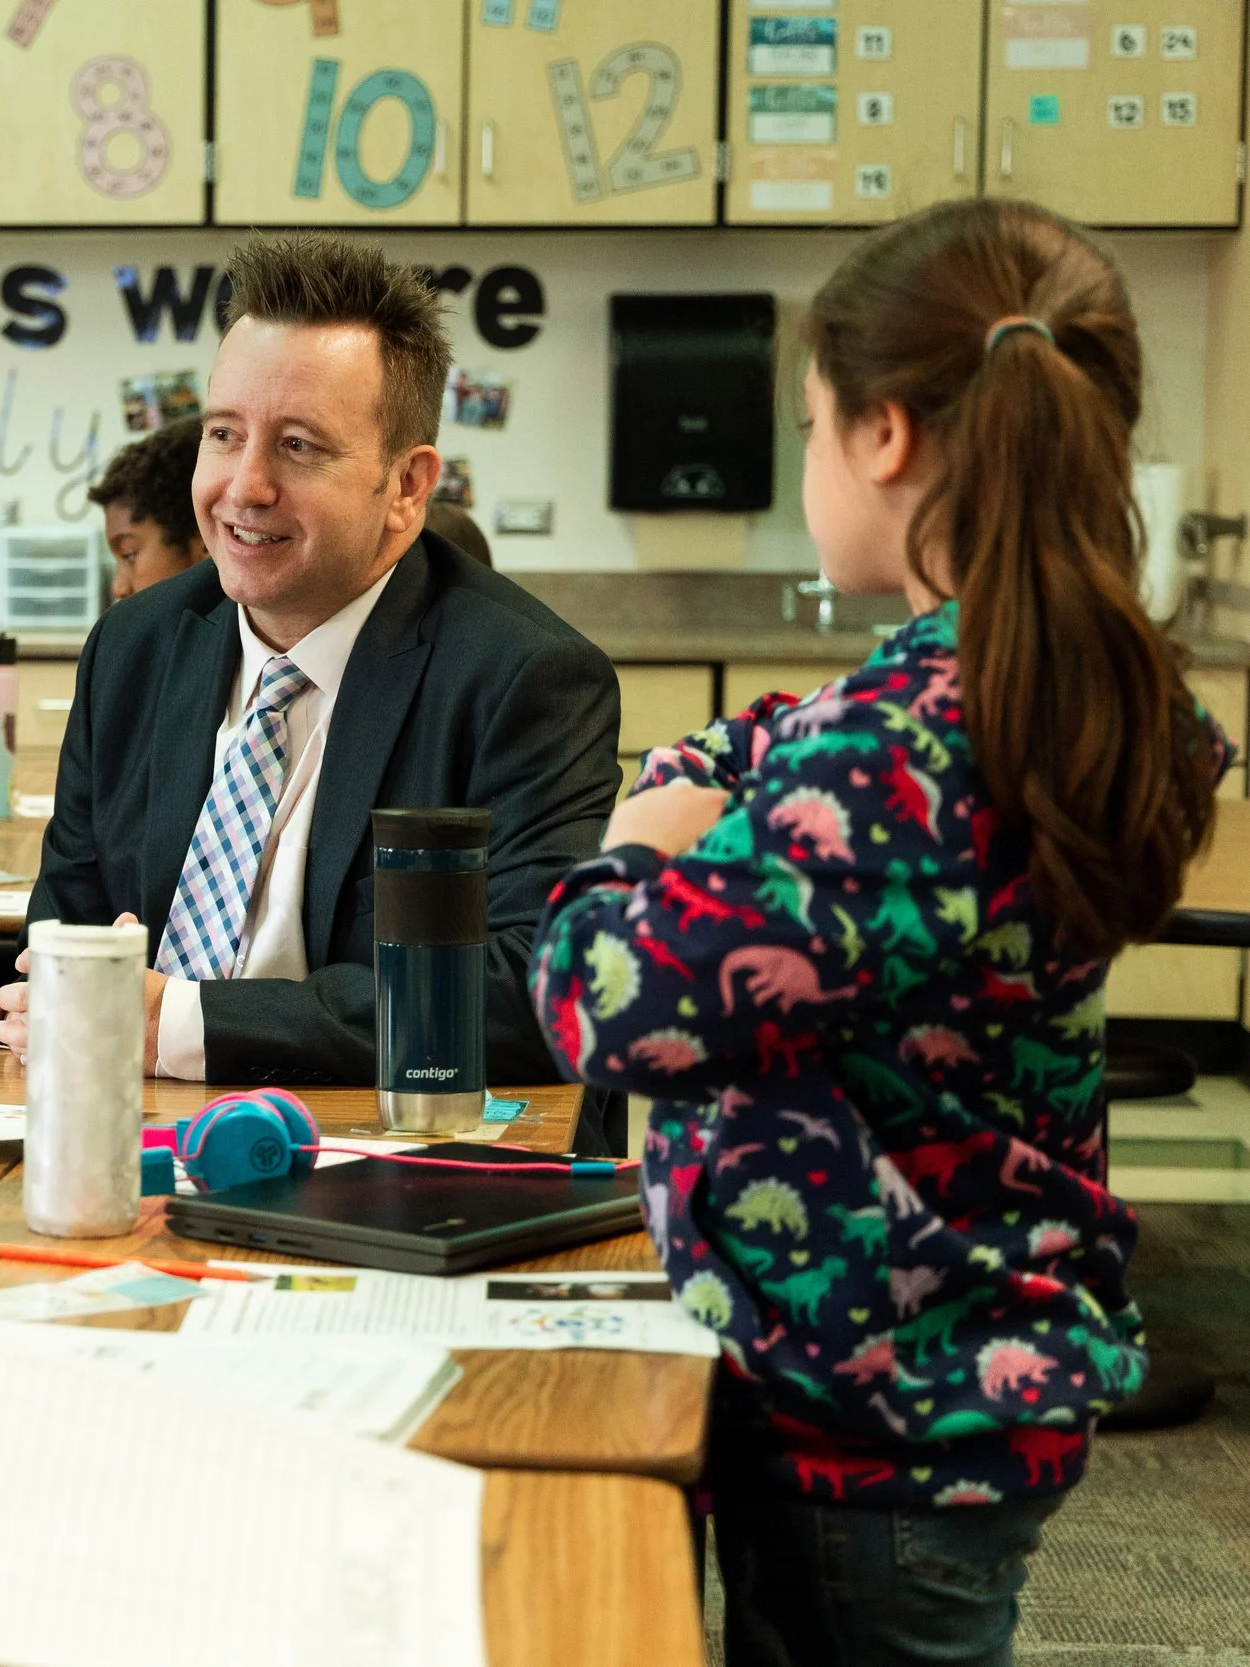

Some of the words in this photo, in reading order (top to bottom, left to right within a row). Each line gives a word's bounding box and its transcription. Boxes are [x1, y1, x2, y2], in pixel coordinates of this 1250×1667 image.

[70, 54, 171, 200] 8
[291, 56, 438, 209] 10
[547, 41, 702, 205] 12
[113, 264, 235, 344] w
[405, 1067, 455, 1081] contigo
